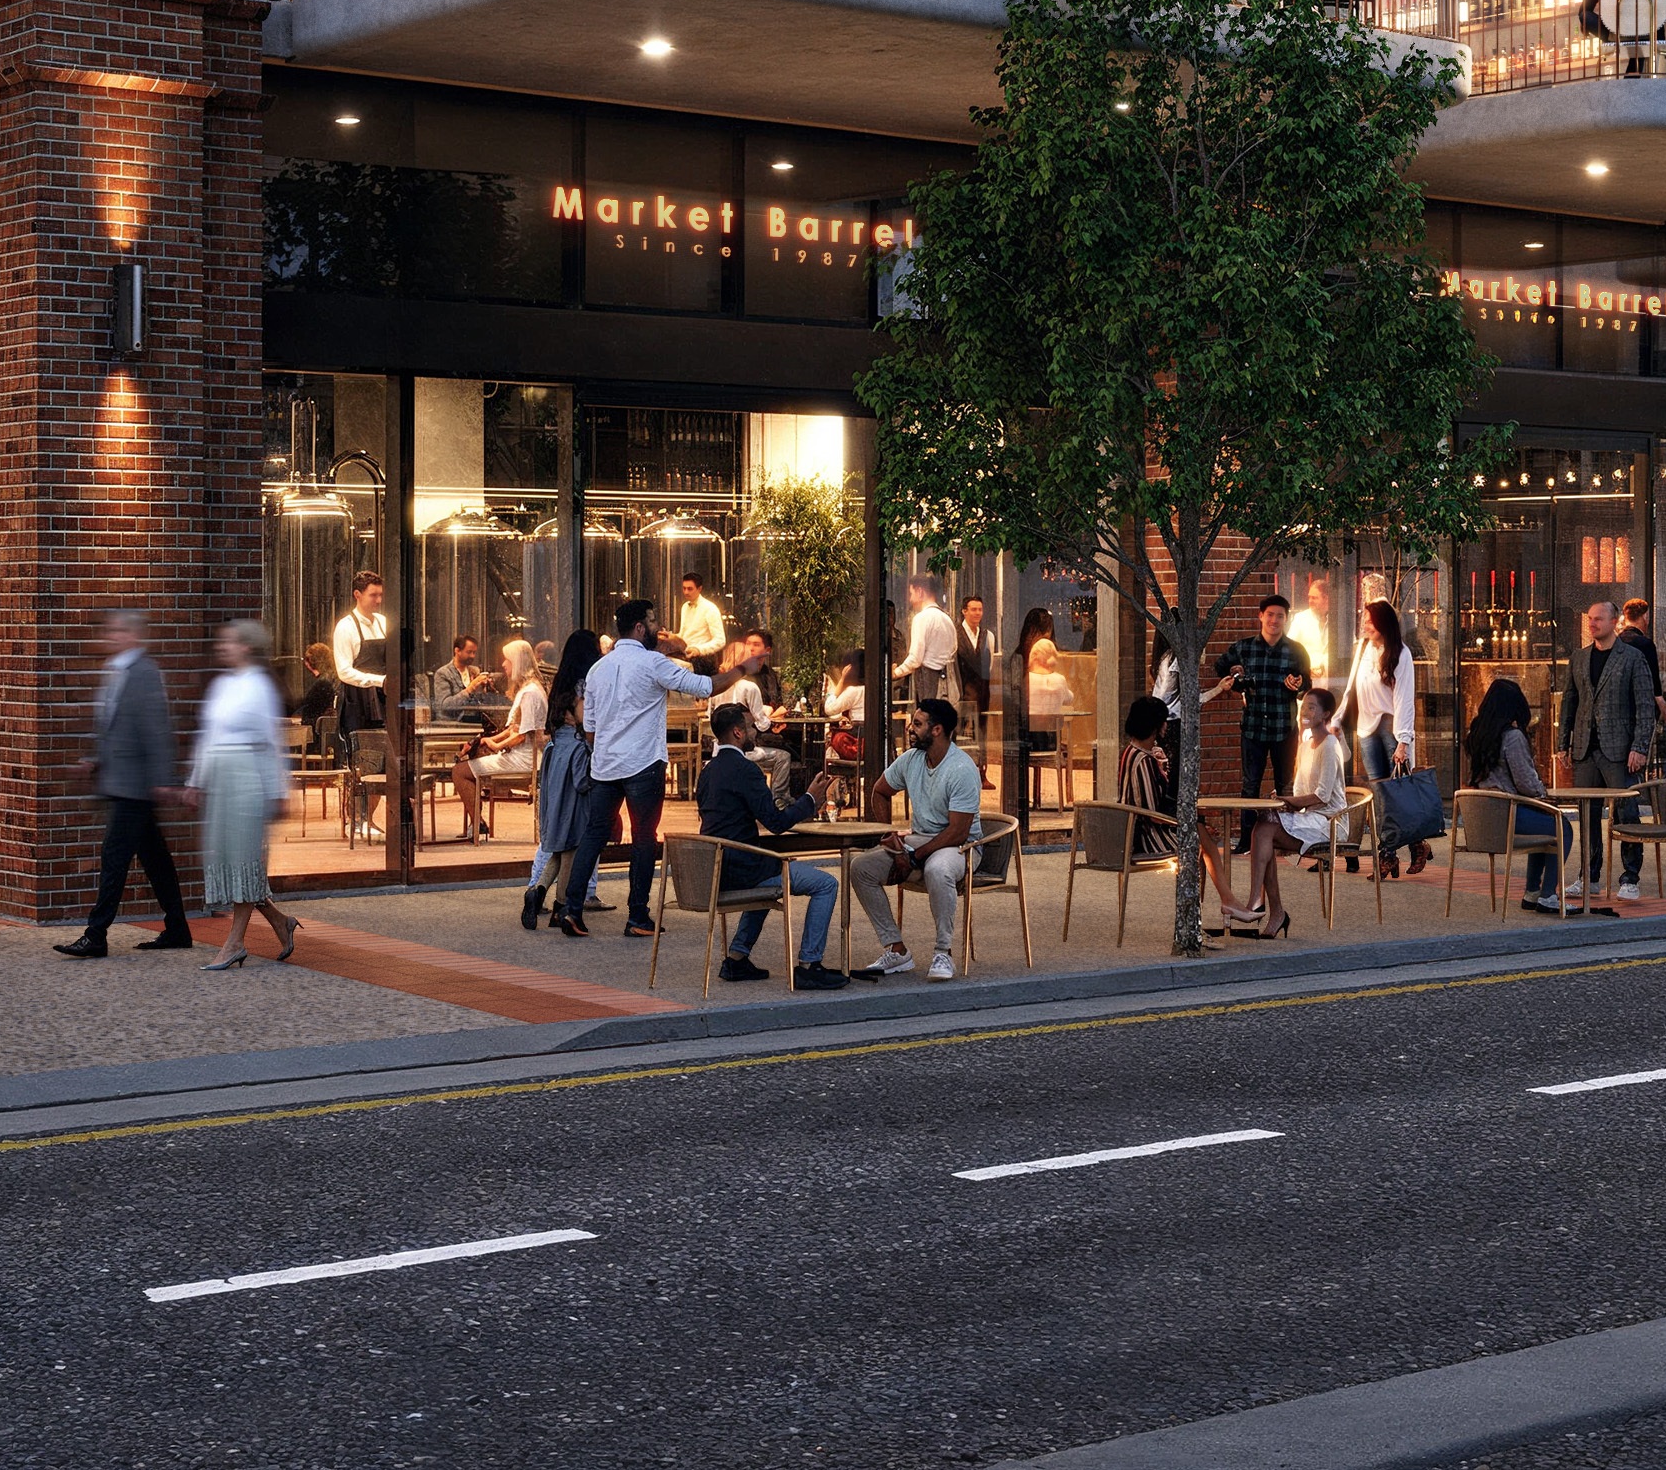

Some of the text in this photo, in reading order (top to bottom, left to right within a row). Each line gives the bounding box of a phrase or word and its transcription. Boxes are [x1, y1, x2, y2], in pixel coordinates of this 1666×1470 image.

[552, 186, 913, 249] Market Barrel
[615, 234, 858, 268] Since 1987
[1580, 316, 1637, 332] 1987
